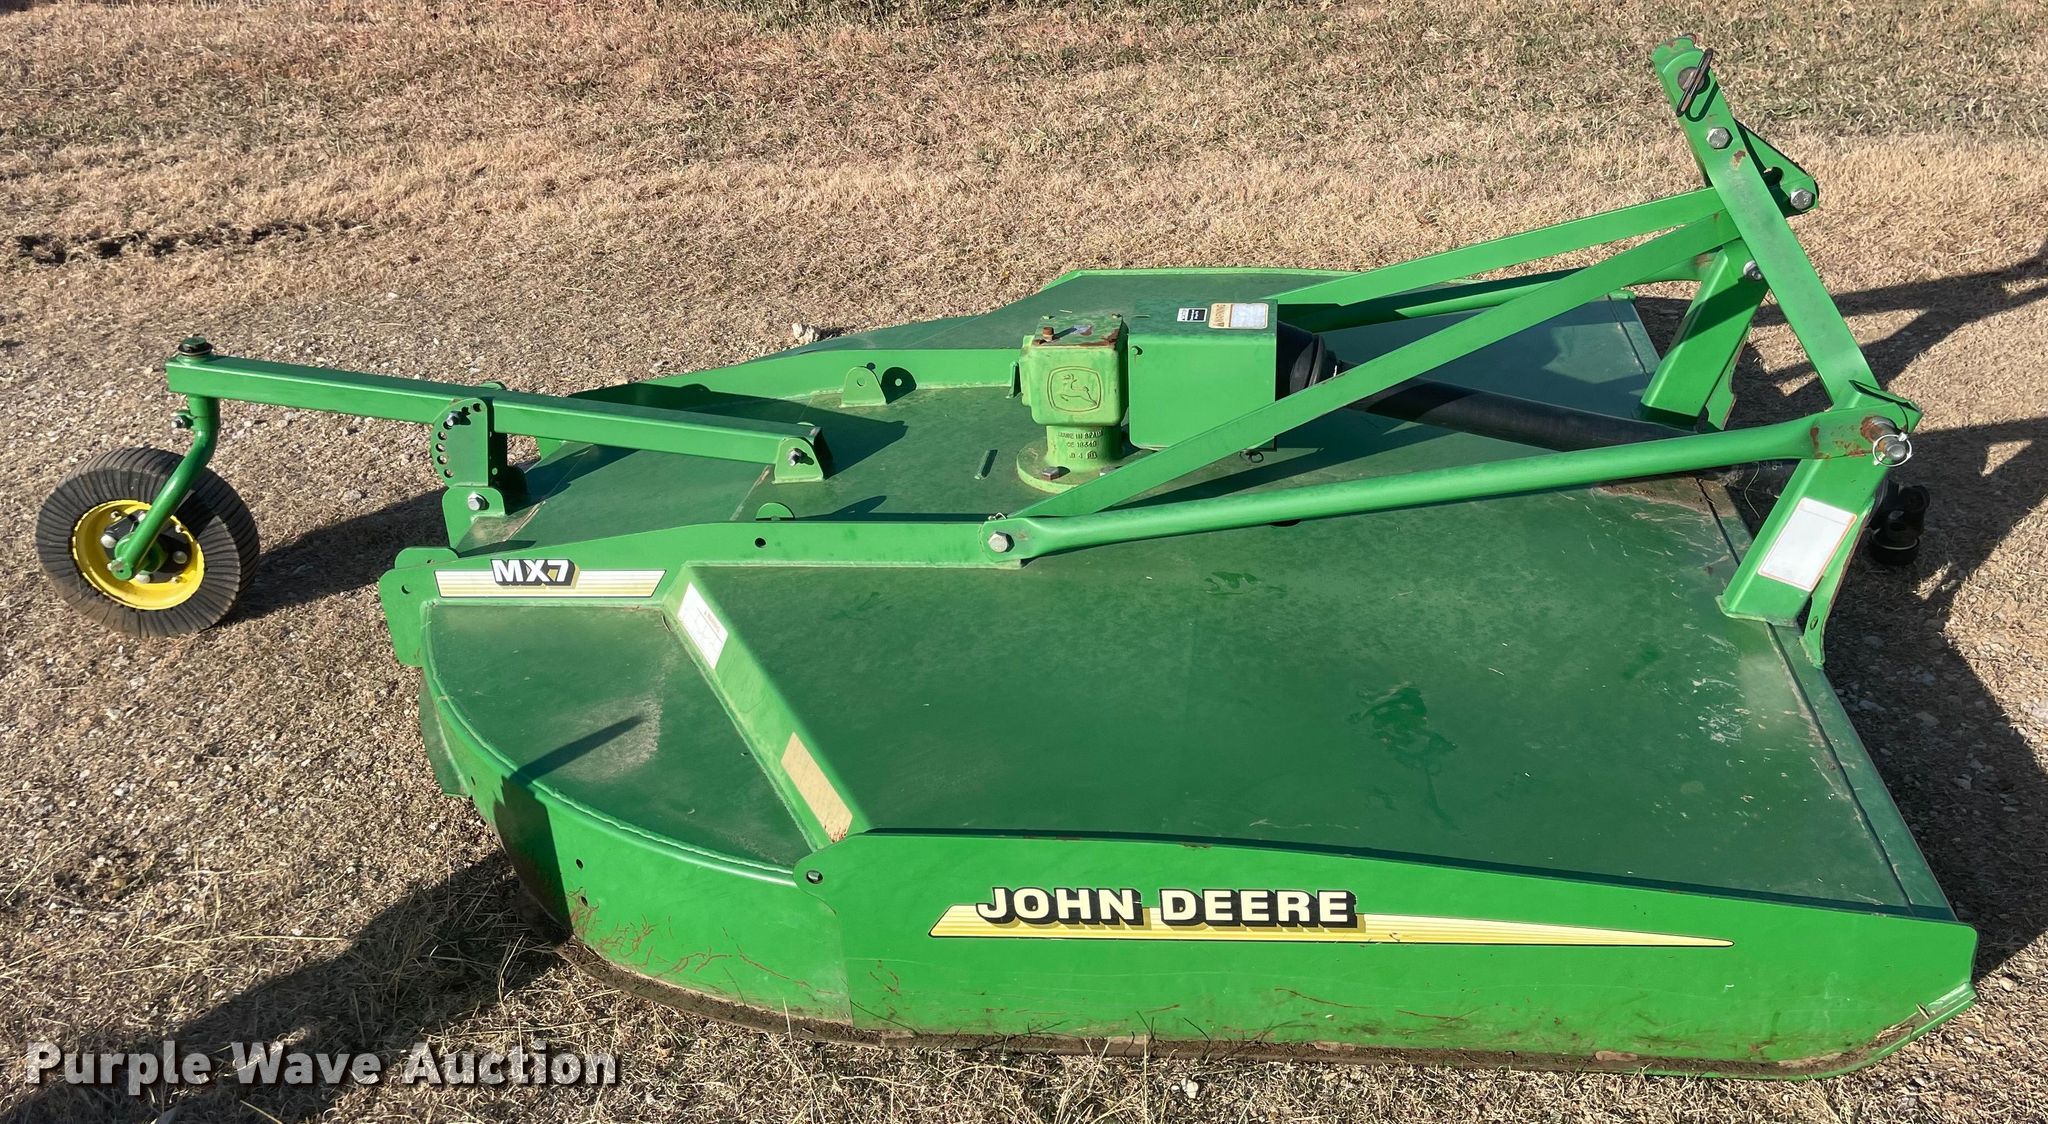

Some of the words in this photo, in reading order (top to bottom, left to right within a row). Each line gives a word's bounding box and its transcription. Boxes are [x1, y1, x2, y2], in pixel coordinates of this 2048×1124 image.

[490, 559, 574, 586] MX7
[976, 887, 1142, 925] JOHN
[1159, 889, 1357, 928] DEERE
